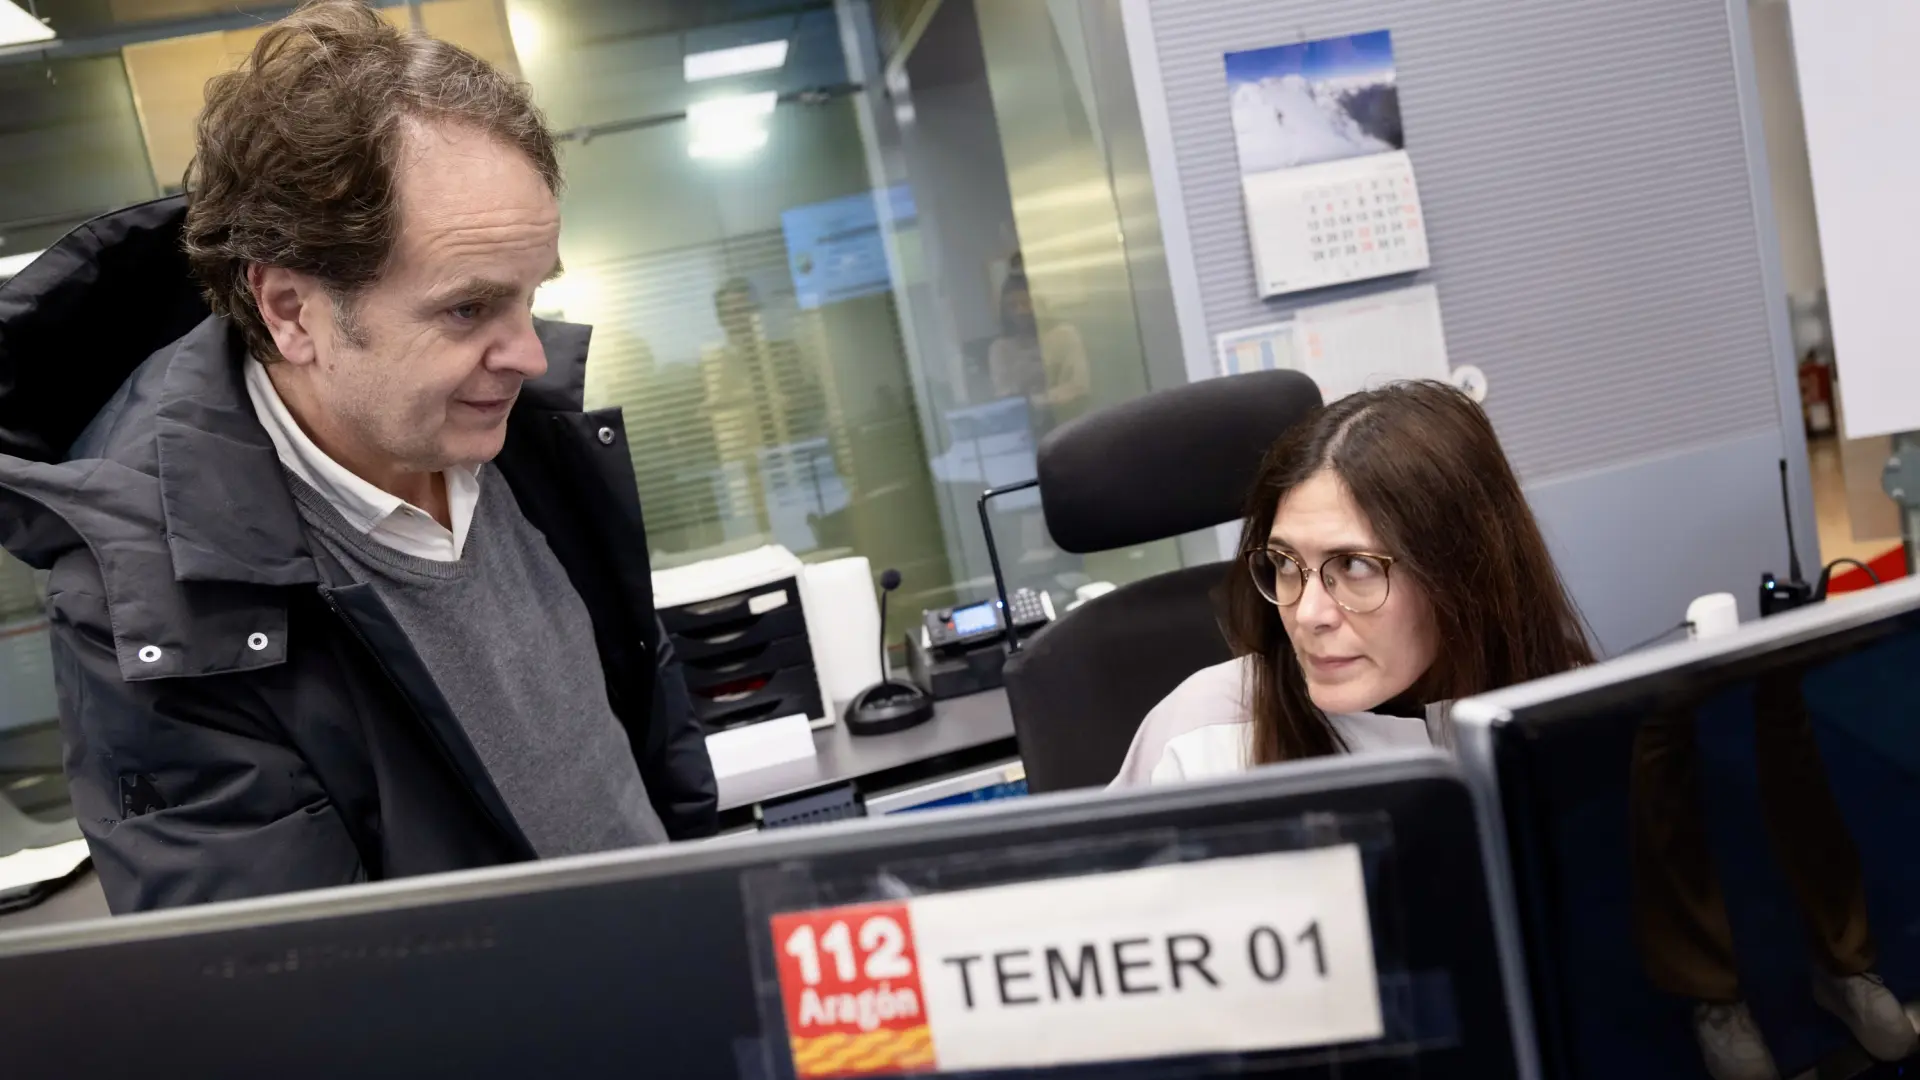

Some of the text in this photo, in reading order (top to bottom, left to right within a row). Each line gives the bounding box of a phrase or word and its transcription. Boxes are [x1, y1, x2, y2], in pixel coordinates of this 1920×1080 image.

[785, 916, 912, 985] 112
[943, 919, 1329, 1011] TEMER 01
[799, 980, 919, 1032] Aragón
